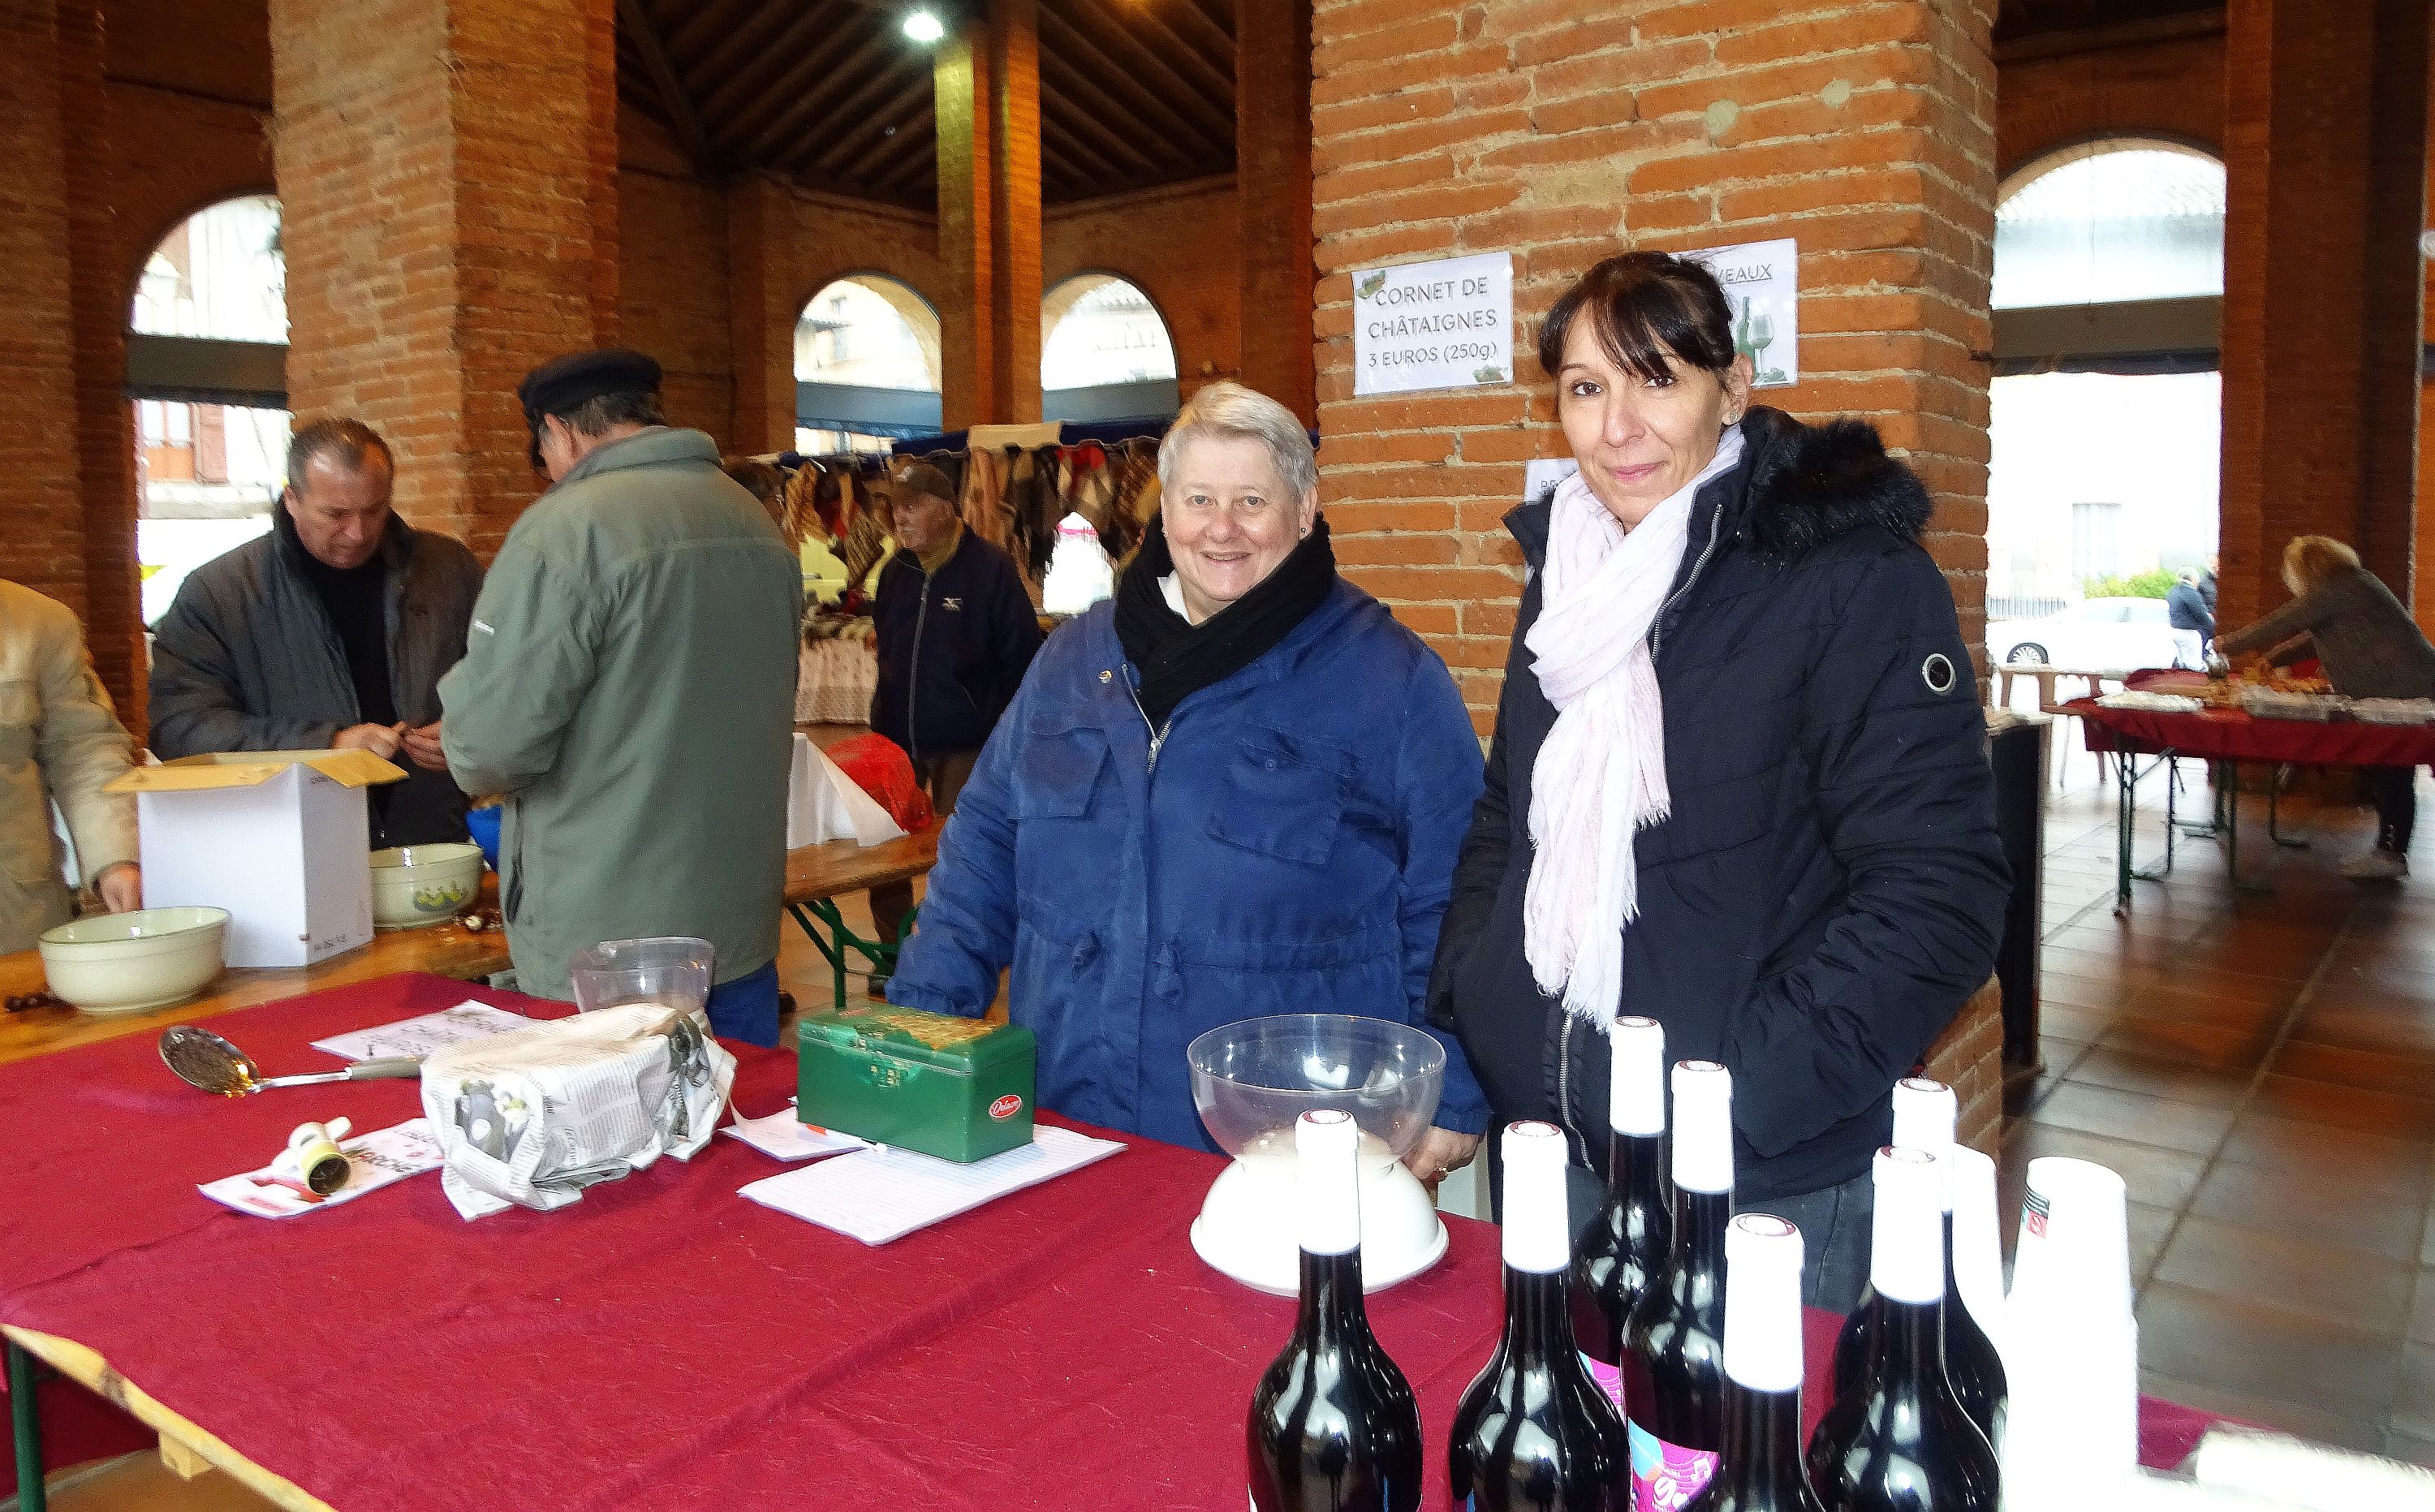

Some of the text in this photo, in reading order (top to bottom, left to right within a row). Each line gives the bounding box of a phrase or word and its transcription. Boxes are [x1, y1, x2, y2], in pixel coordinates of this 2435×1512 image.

[1375, 277, 1488, 307] CORNET DE
[1368, 308, 1497, 339] CHÂTAIGNES
[1368, 341, 1498, 368] 3 EUROS (250g)
